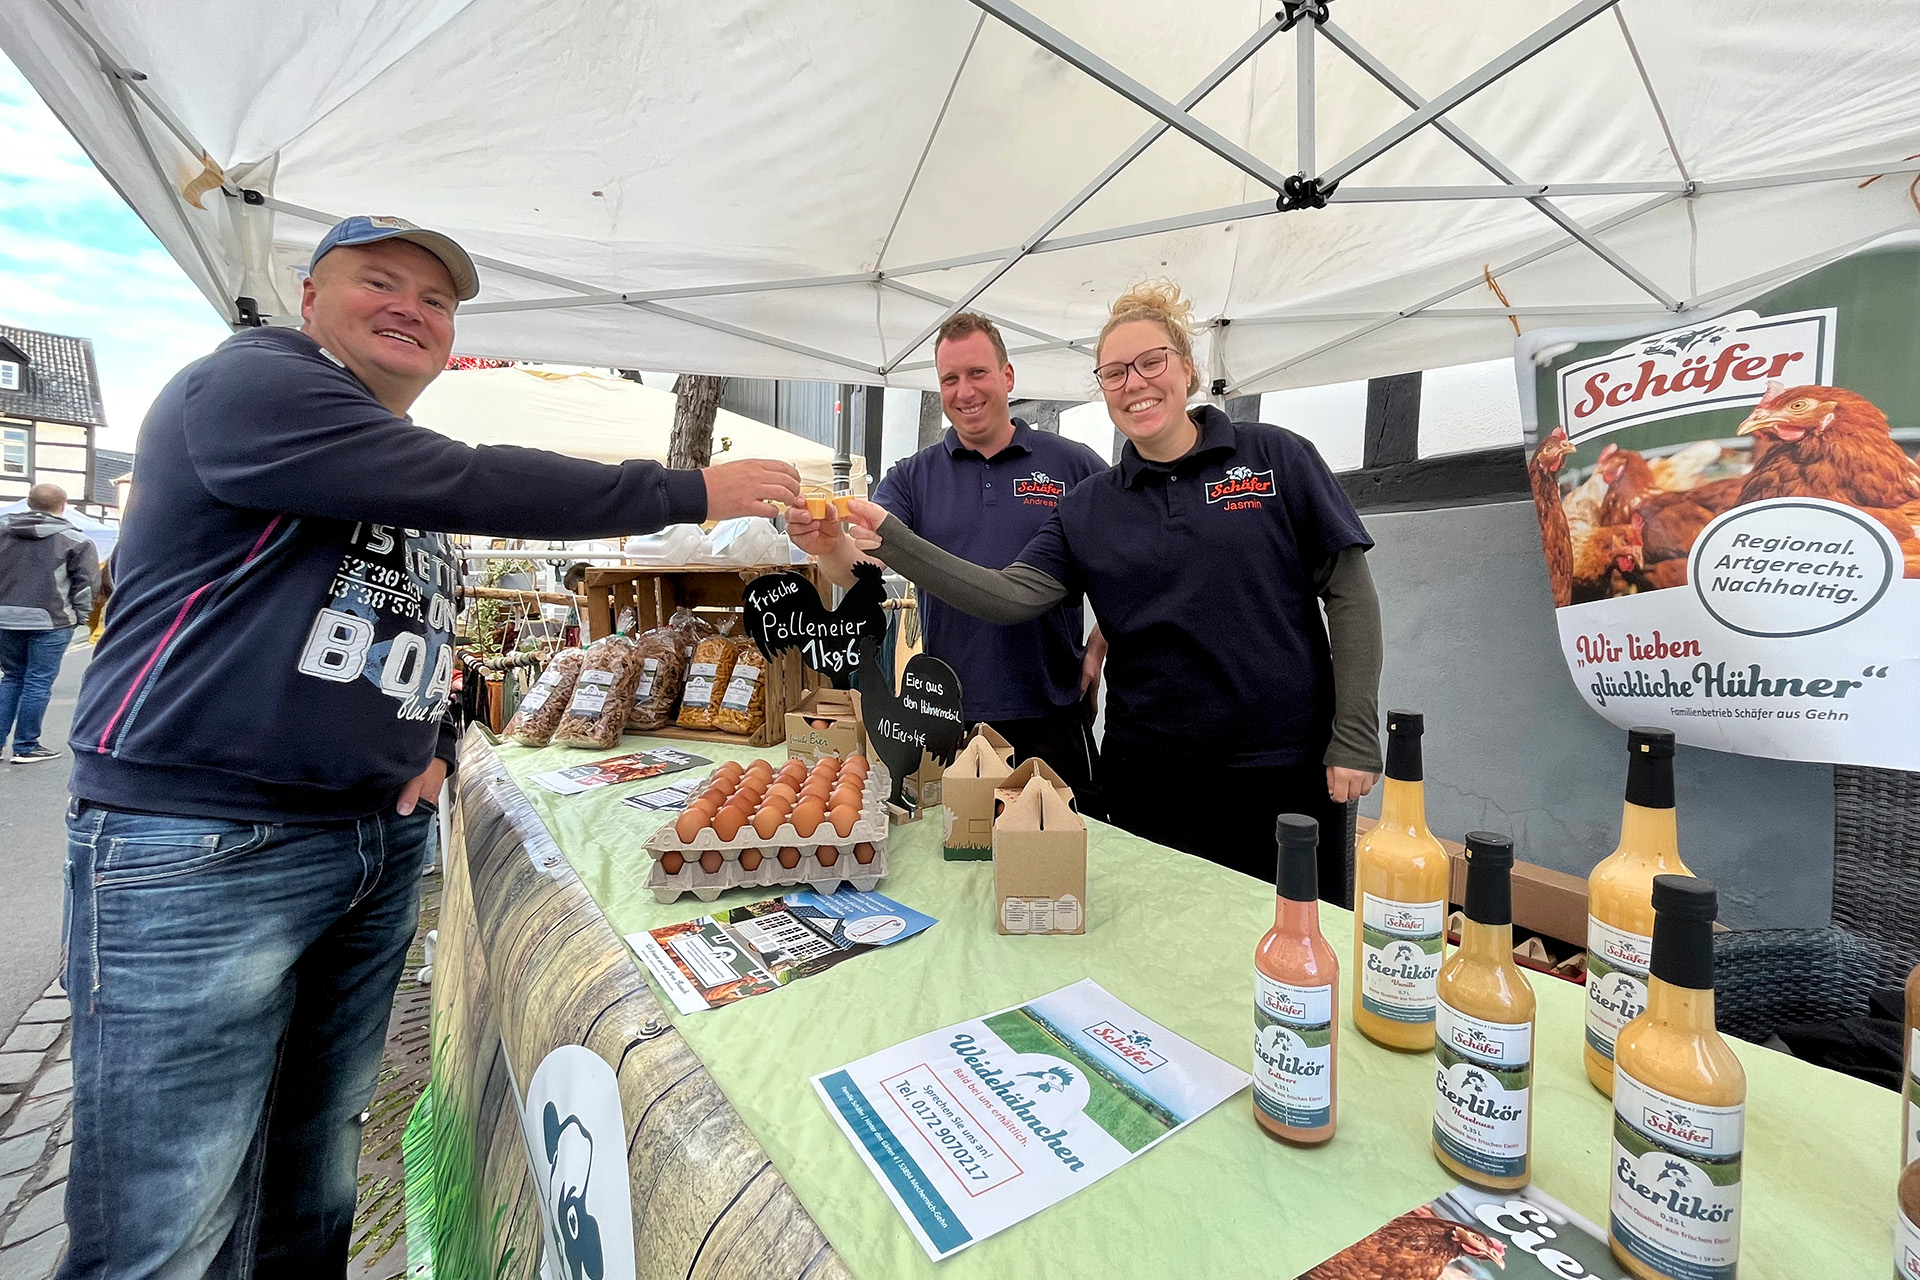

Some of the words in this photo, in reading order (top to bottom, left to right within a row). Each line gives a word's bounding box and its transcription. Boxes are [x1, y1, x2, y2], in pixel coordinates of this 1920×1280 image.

[1574, 343, 1804, 418] Schäfer
[1017, 478, 1062, 496] Schäfer
[1210, 476, 1272, 498] Schäfer
[1224, 499, 1262, 511] Jasmin
[1732, 533, 1856, 556] Regional.
[1713, 554, 1865, 580] Artgerecht.
[748, 581, 799, 611] Frische
[1711, 577, 1859, 604] Nachhaltig.
[763, 611, 867, 642] Pölleneier
[1629, 632, 1702, 661] lieben
[906, 672, 923, 690] Eier
[926, 681, 944, 696] aus
[1591, 672, 1693, 707] glückliche
[1670, 707, 1733, 718] Familienbetrieb
[1734, 708, 1774, 721] Schäfer
[1776, 710, 1800, 719] aus
[1805, 709, 1849, 721] Gehn
[809, 731, 829, 746] Eier
[878, 717, 891, 738] 10
[1387, 917, 1423, 930] Schäfer
[1367, 953, 1438, 980] Eierlikör
[1607, 945, 1649, 966] Schäfer
[1266, 996, 1303, 1015] Schäfer
[1092, 1026, 1155, 1068] Schäfer
[1455, 1033, 1501, 1055] Schäfer
[949, 1033, 1086, 1173] Weidehähnchen
[953, 1068, 973, 1085] Bald
[967, 1083, 983, 1097] bei
[978, 1094, 994, 1111] uns
[991, 1109, 1029, 1148] erhältlich.
[1436, 1070, 1522, 1122] Eierlikör
[896, 1079, 918, 1101] Tel.
[911, 1100, 942, 1129] 0172
[934, 1127, 989, 1180] 9070217
[923, 1084, 954, 1118] Sprechen
[951, 1116, 965, 1130] Sie
[962, 1129, 979, 1144] uns
[975, 1143, 994, 1160] an!
[1452, 1106, 1495, 1130] Haselnuss
[1462, 1124, 1477, 1134] 0,35
[1646, 1114, 1710, 1144] Schäfer
[1617, 1156, 1735, 1223] Eierlikör
[1660, 1212, 1679, 1225] 0,35
[1665, 1226, 1680, 1236] aus
[1681, 1231, 1713, 1245] frischen
